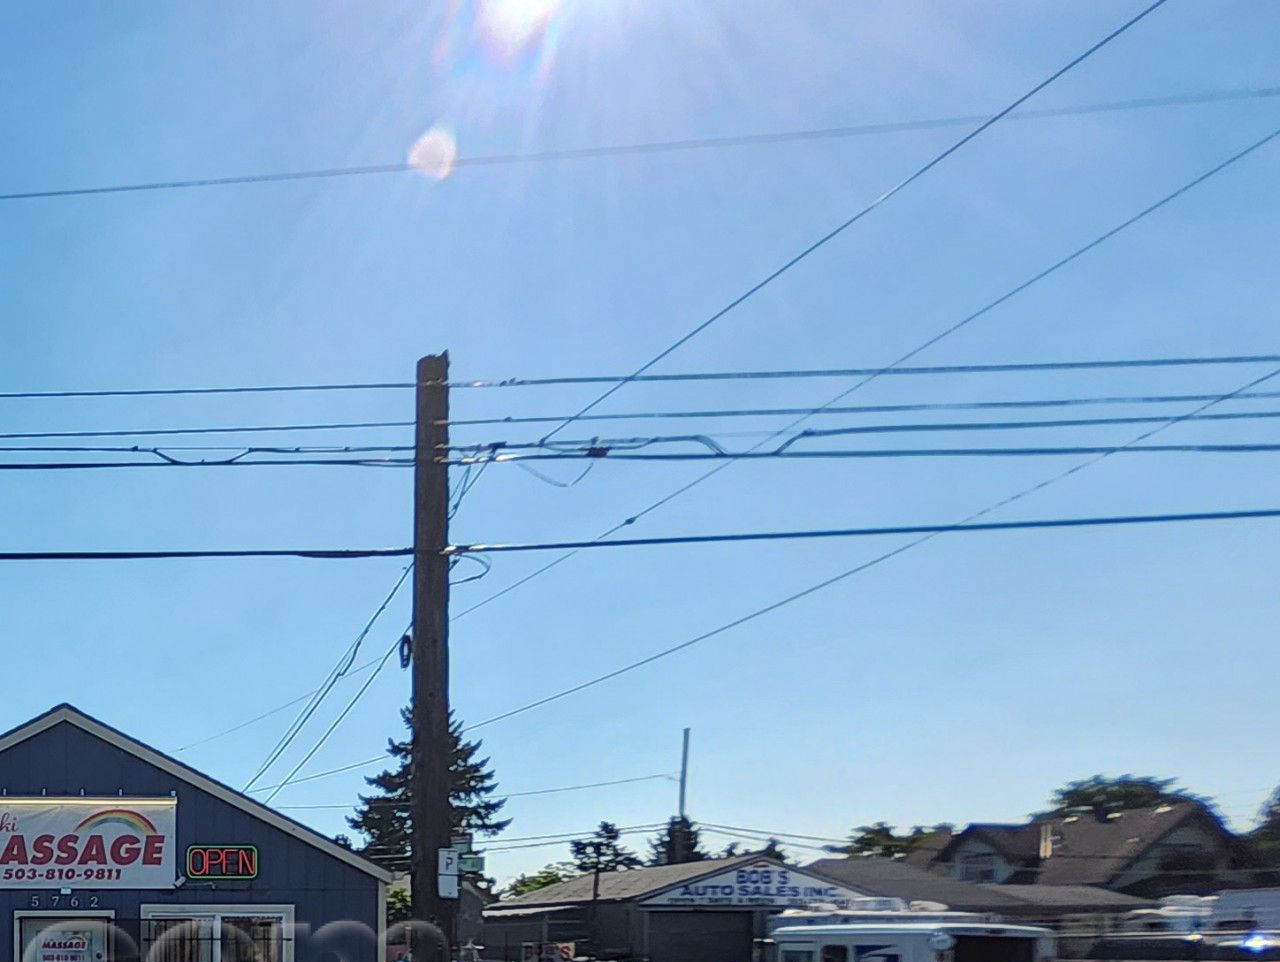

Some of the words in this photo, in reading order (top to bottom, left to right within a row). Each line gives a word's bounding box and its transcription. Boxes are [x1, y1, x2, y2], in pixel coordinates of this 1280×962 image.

[189, 849, 257, 875] OPEN
[2, 868, 122, 881] 503-810-9811
[736, 869, 789, 885] BOB'S
[680, 885, 734, 896] AUTO
[739, 885, 799, 897] SALES
